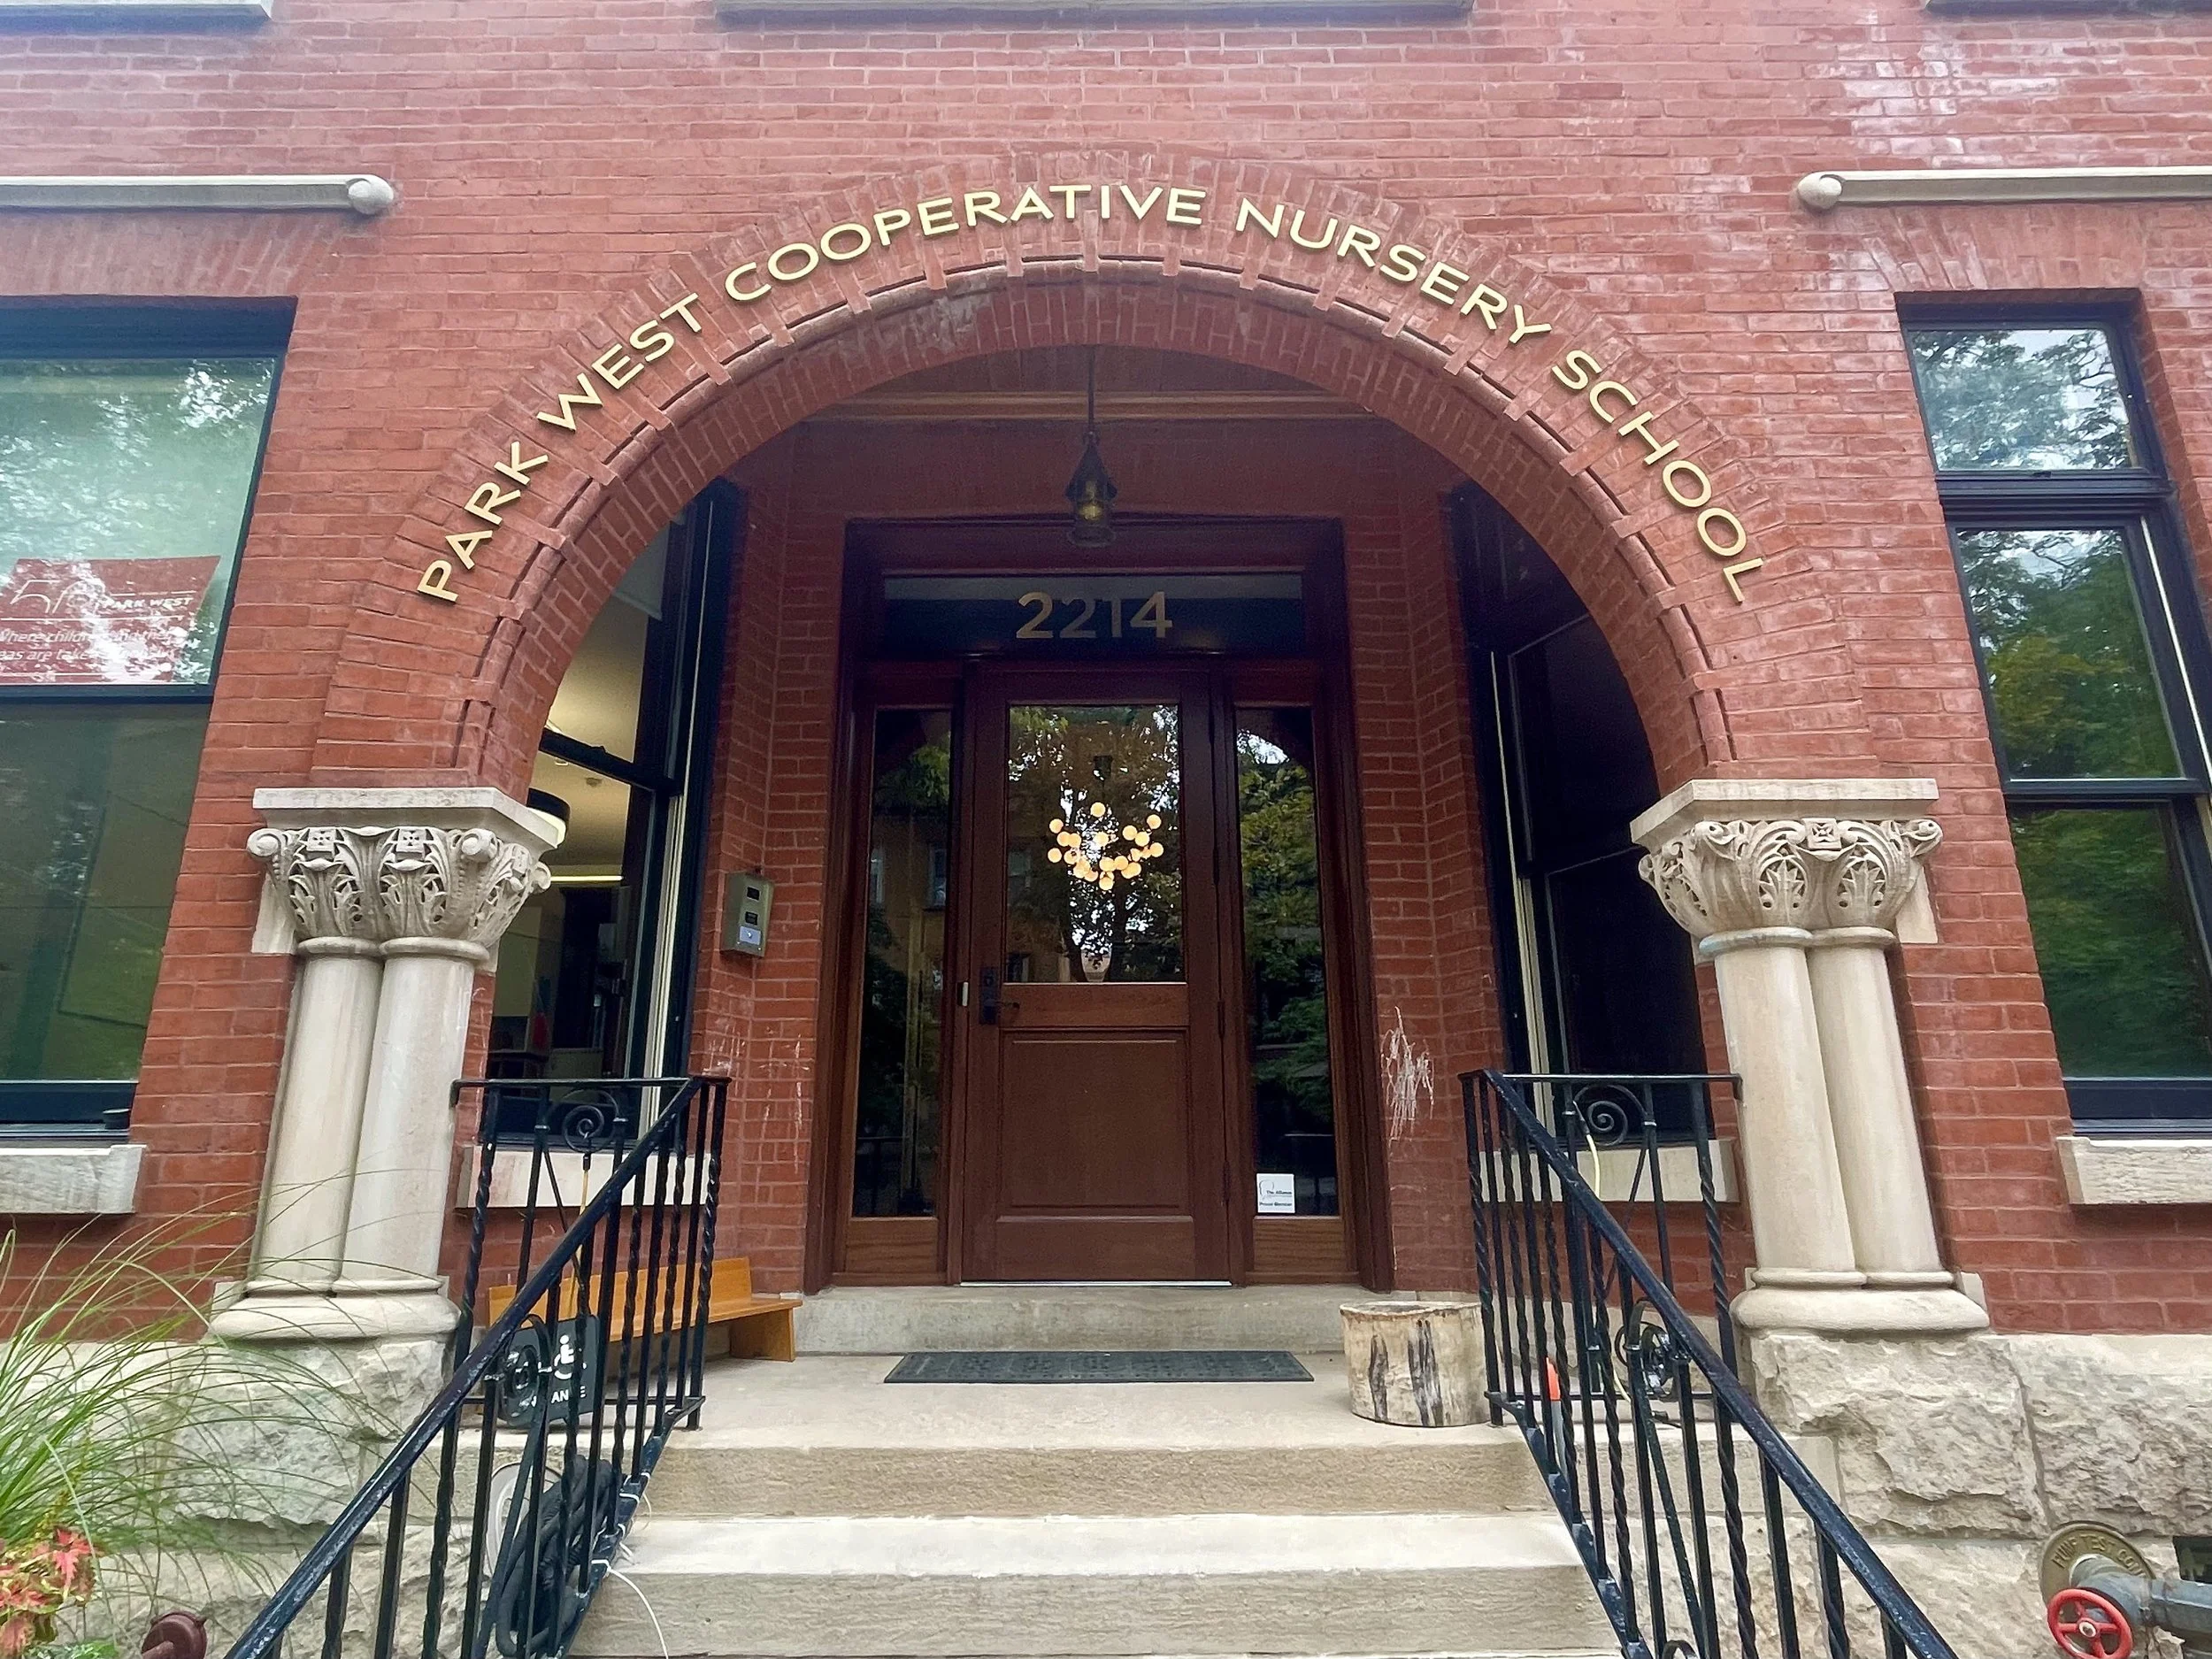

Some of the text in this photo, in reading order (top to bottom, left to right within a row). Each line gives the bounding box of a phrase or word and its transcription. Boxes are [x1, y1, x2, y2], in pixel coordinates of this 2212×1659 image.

[416, 183, 1764, 603] PARK WEST COOPERATIVE NURSERY SCHOOL
[1016, 591, 1173, 639] 2214
[2079, 1533, 2116, 1554] TEST
